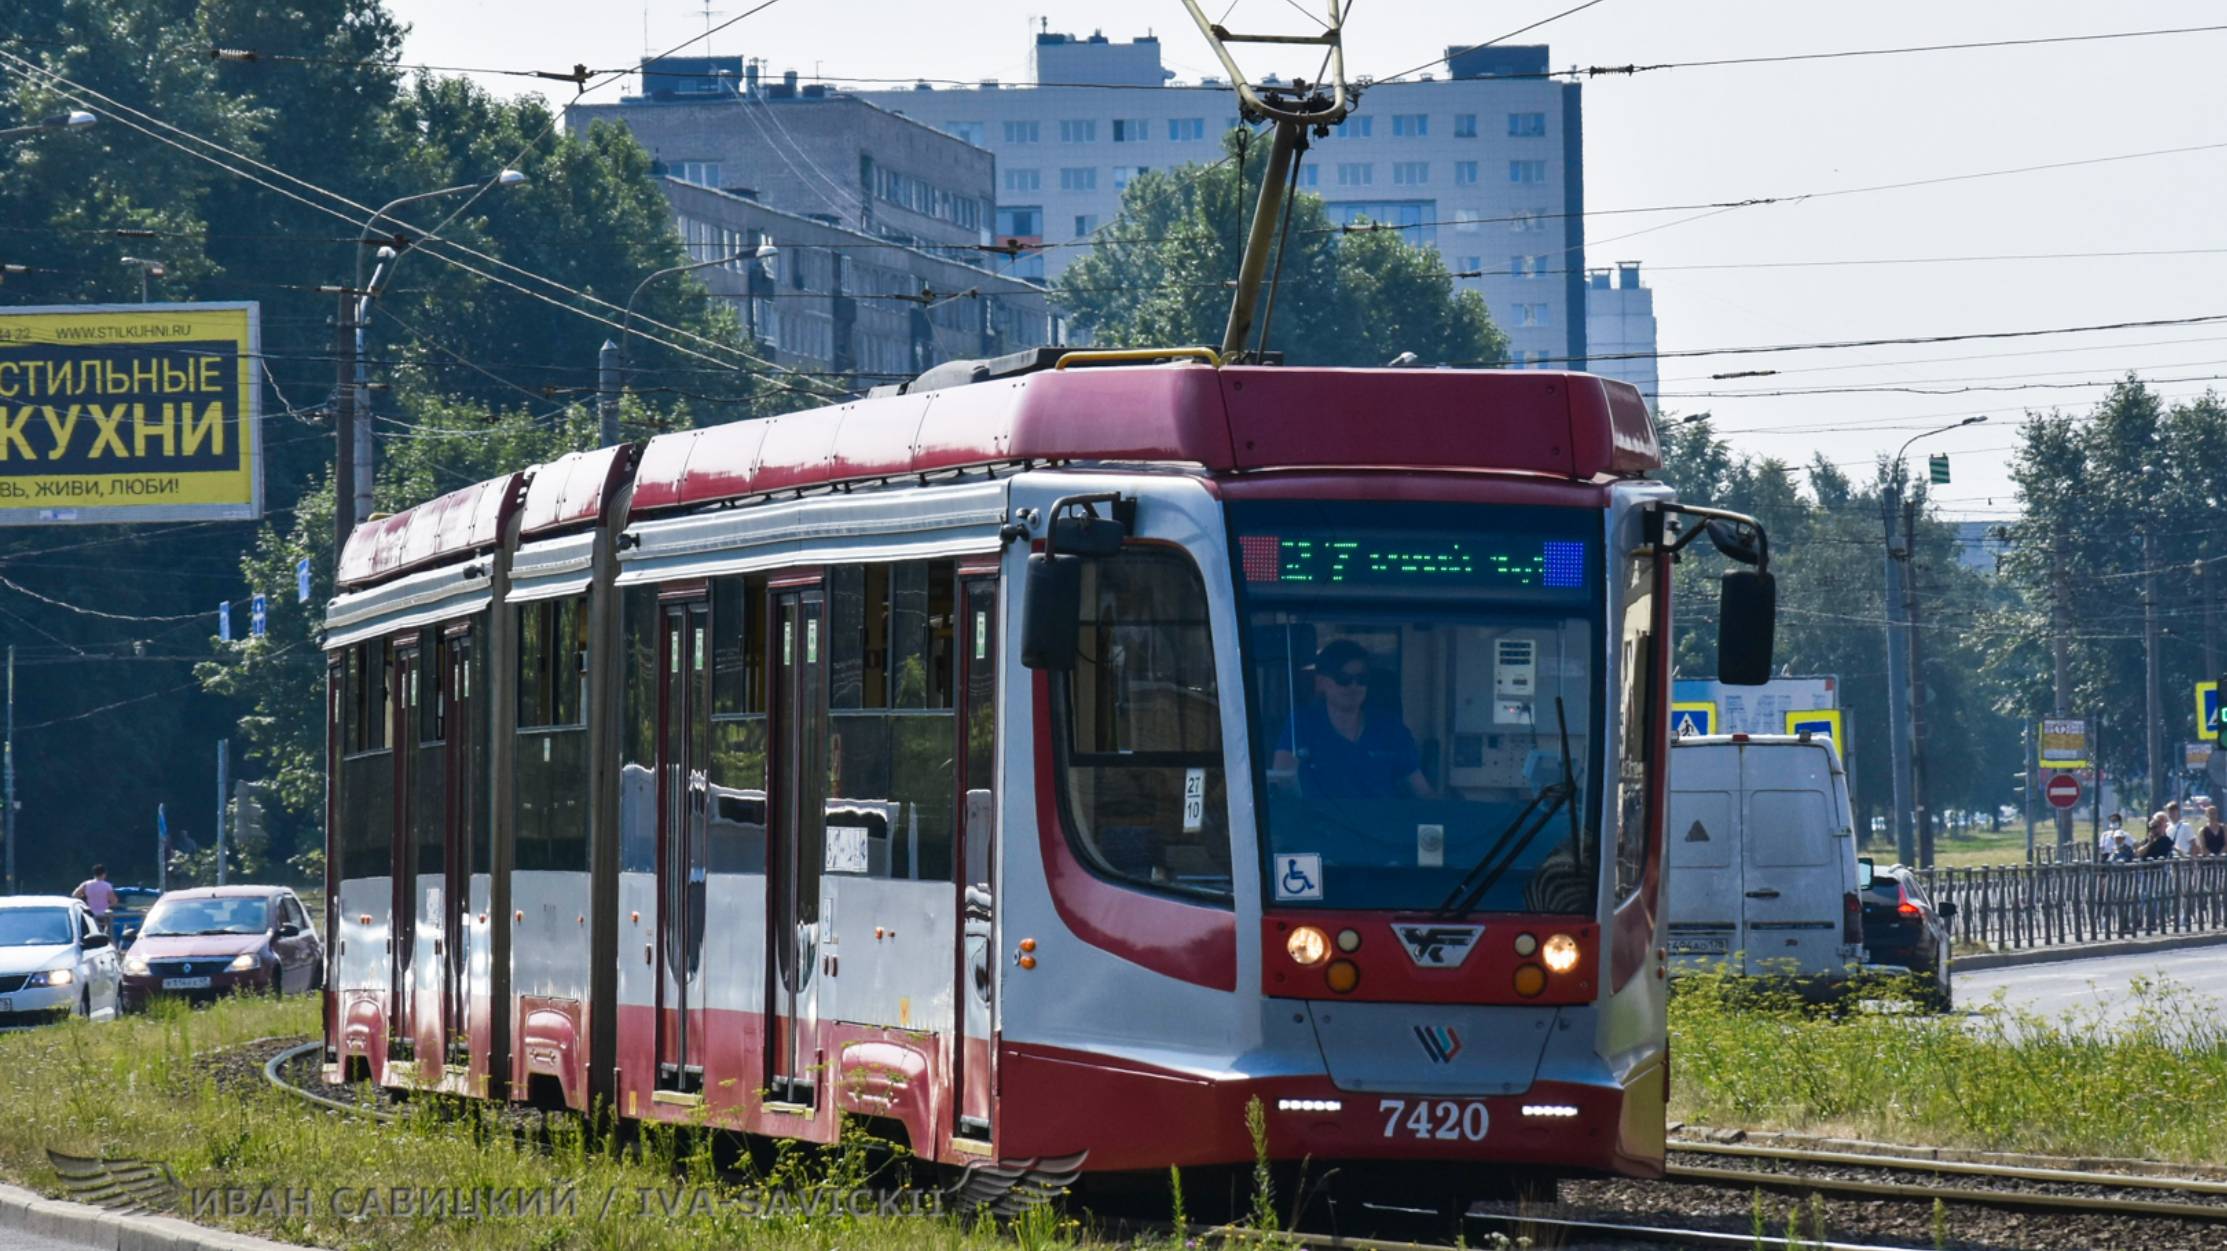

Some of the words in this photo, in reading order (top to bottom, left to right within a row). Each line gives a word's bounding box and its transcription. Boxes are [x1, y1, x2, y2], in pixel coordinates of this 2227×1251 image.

[55, 325, 192, 340] WWW.STILKUHNI.RU
[0, 357, 223, 397] СТИЛЬНЫЕ
[0, 401, 224, 461] КУХНИ
[35, 480, 104, 498] ЖИВИ,
[109, 478, 179, 495] ЛЮБИ!
[1187, 776, 1201, 794] 27
[1187, 801, 1200, 819] 10
[1378, 1099, 1490, 1142] 7420
